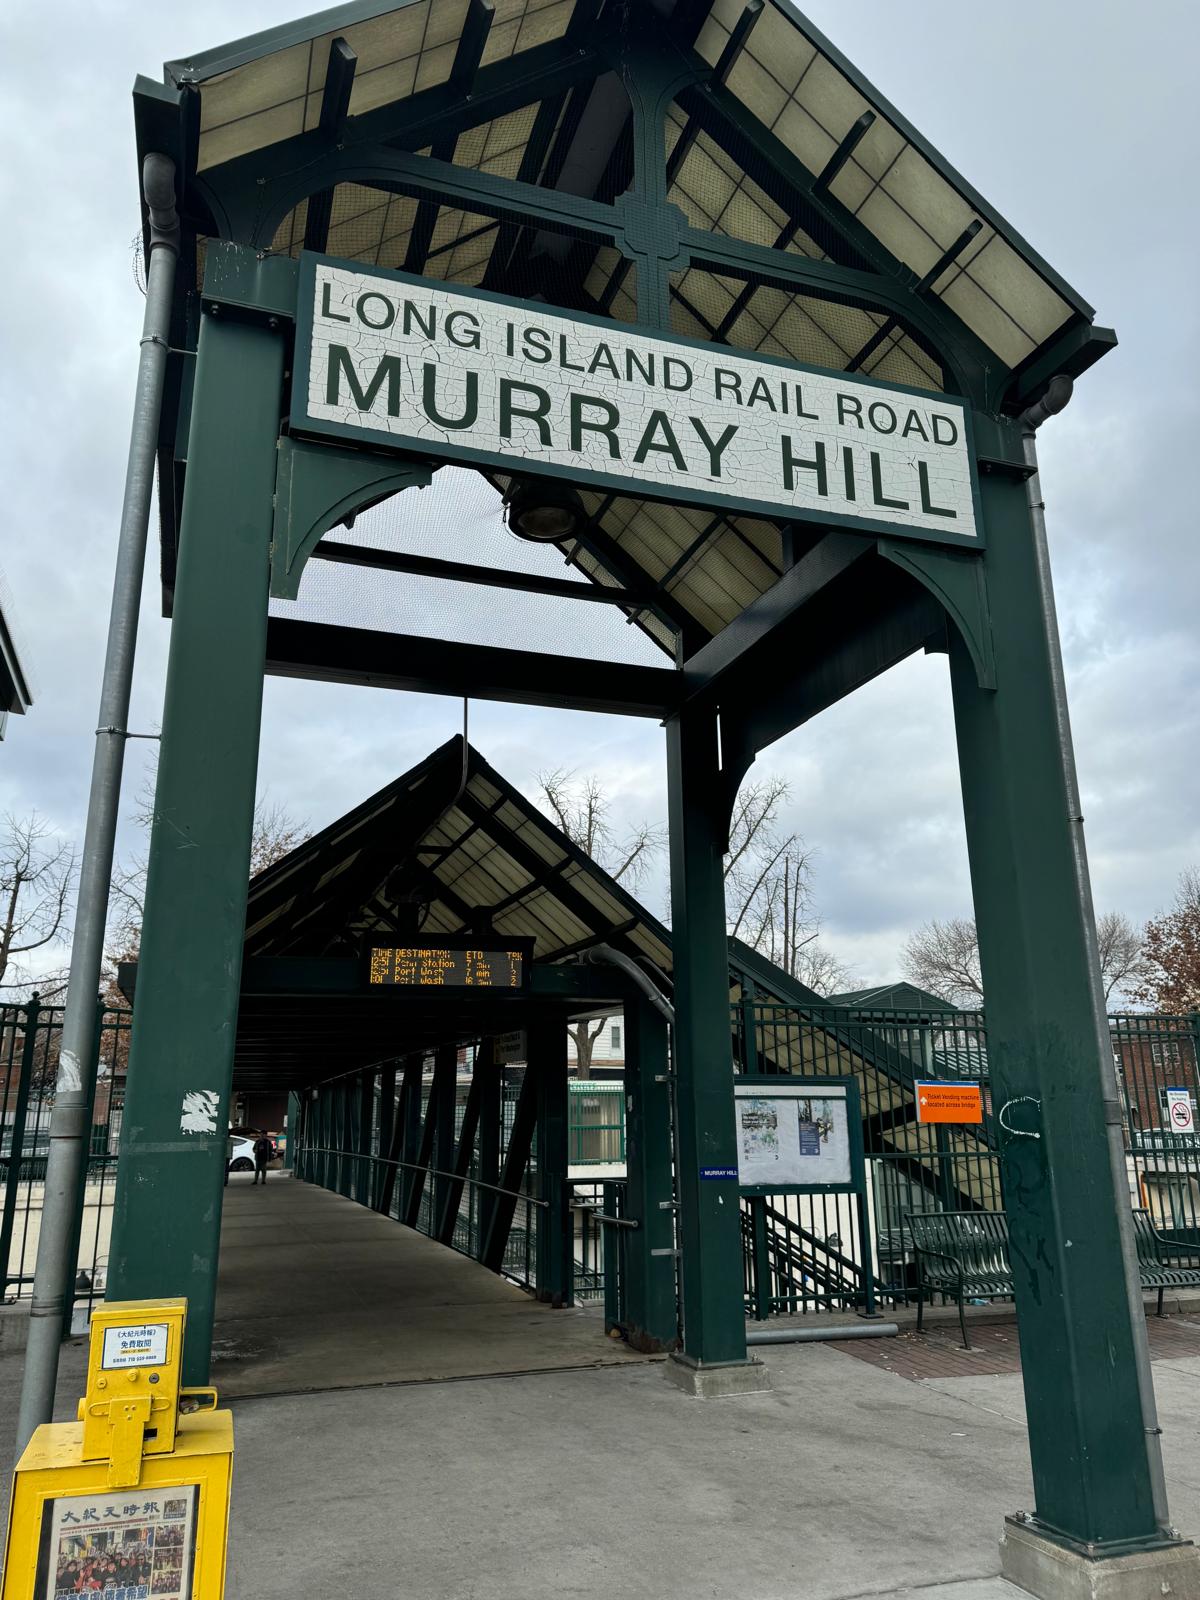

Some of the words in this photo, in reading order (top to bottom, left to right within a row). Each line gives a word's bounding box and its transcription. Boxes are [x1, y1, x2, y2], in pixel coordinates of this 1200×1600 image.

[320, 282, 483, 350] LONG
[506, 321, 695, 393] ISLAND
[713, 367, 820, 421] RAIL
[836, 393, 960, 447] ROAD
[325, 343, 740, 478] MURRAY
[780, 434, 959, 520] HILL
[372, 947, 393, 958] TIME
[395, 948, 451, 959] DESTINATION
[466, 950, 484, 960] ETD
[506, 951, 523, 961] TRK
[394, 967, 416, 976] Port
[420, 967, 445, 977] Wash
[420, 976, 445, 985] Wash
[60, 1500, 161, 1523] 大紀元時報
